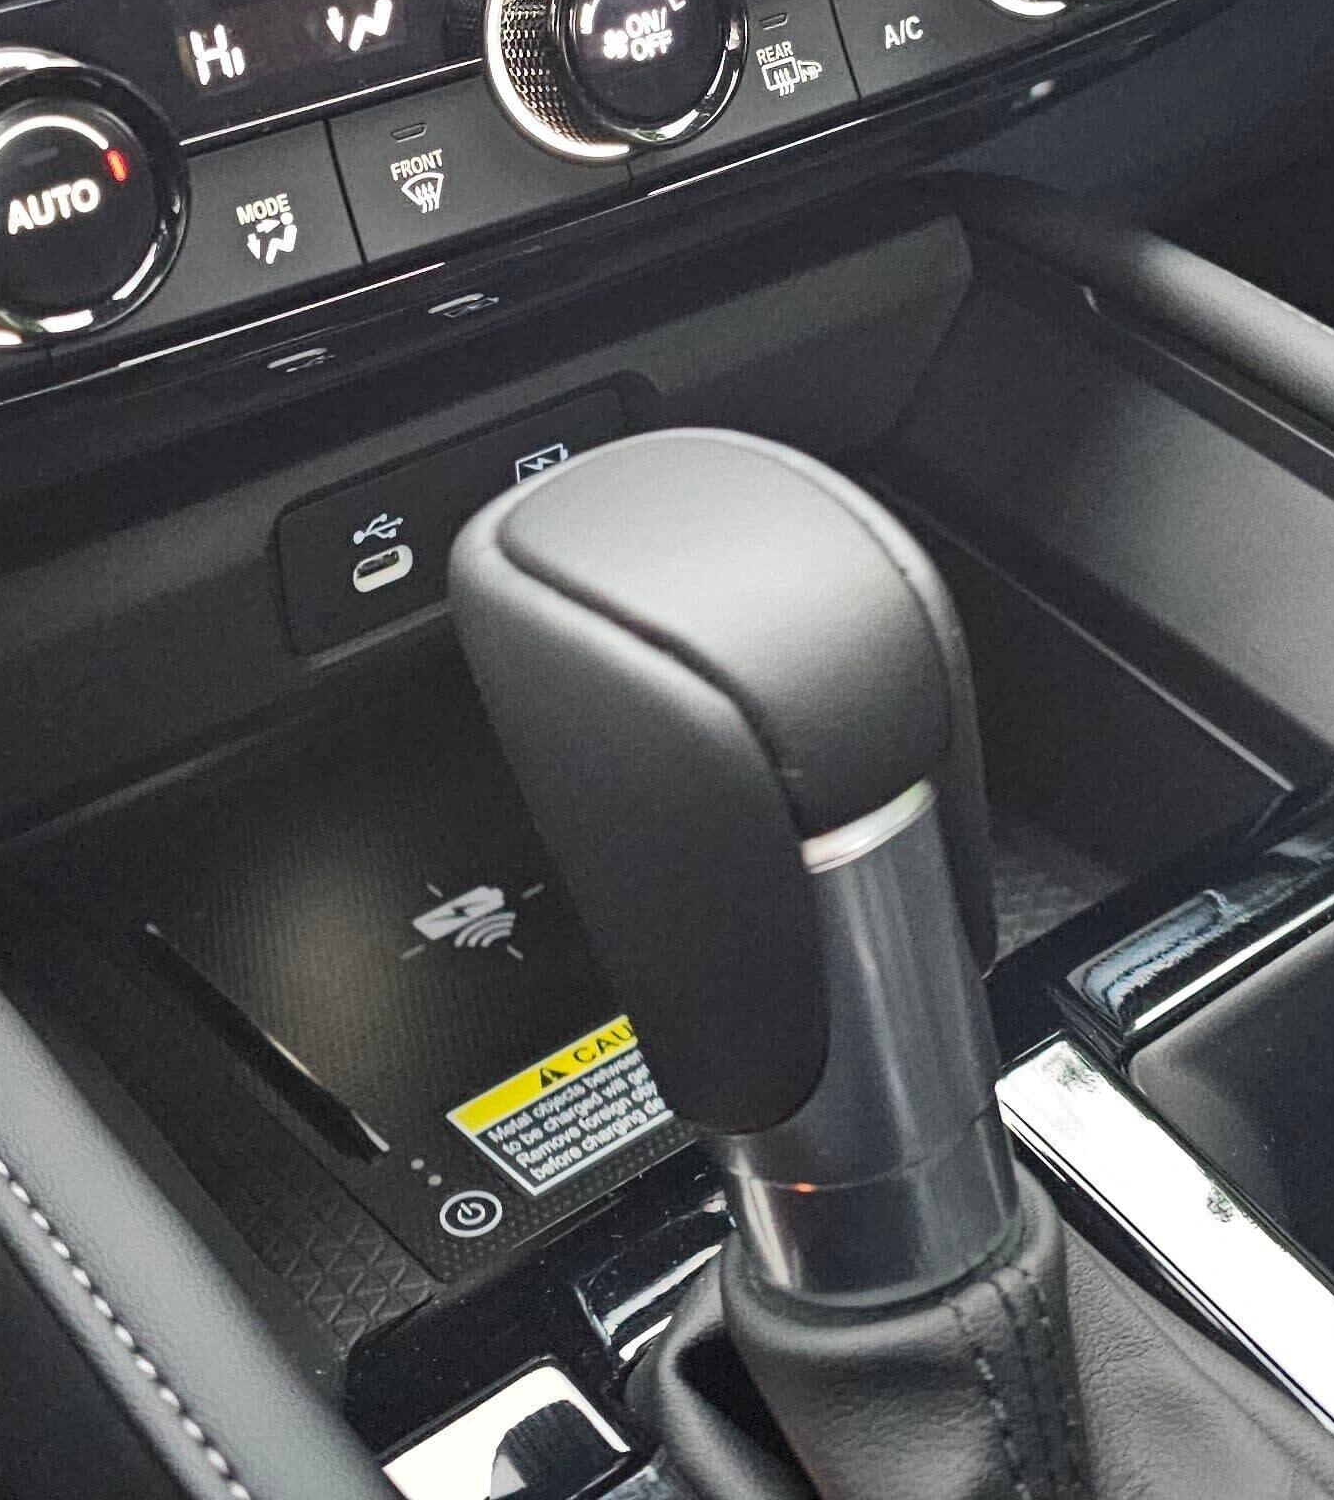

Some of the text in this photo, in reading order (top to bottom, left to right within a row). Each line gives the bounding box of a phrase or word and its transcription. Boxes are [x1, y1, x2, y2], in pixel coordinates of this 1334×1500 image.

[625, 6, 668, 38] ON/
[884, 15, 924, 49] A/C
[631, 29, 673, 62] OFF
[756, 40, 794, 65] REAR
[390, 148, 444, 181] FRONT
[7, 178, 101, 235] AUTO
[236, 193, 291, 225] MODE
[487, 1049, 644, 1144] Metal objects between
[502, 1140, 522, 1156] to
[519, 1127, 544, 1146] be
[543, 1091, 603, 1133] charged
[602, 1077, 629, 1099] will
[516, 1126, 582, 1168] Remove
[578, 1097, 633, 1132] foreign
[529, 1146, 582, 1180] before
[581, 1109, 648, 1151] charging
